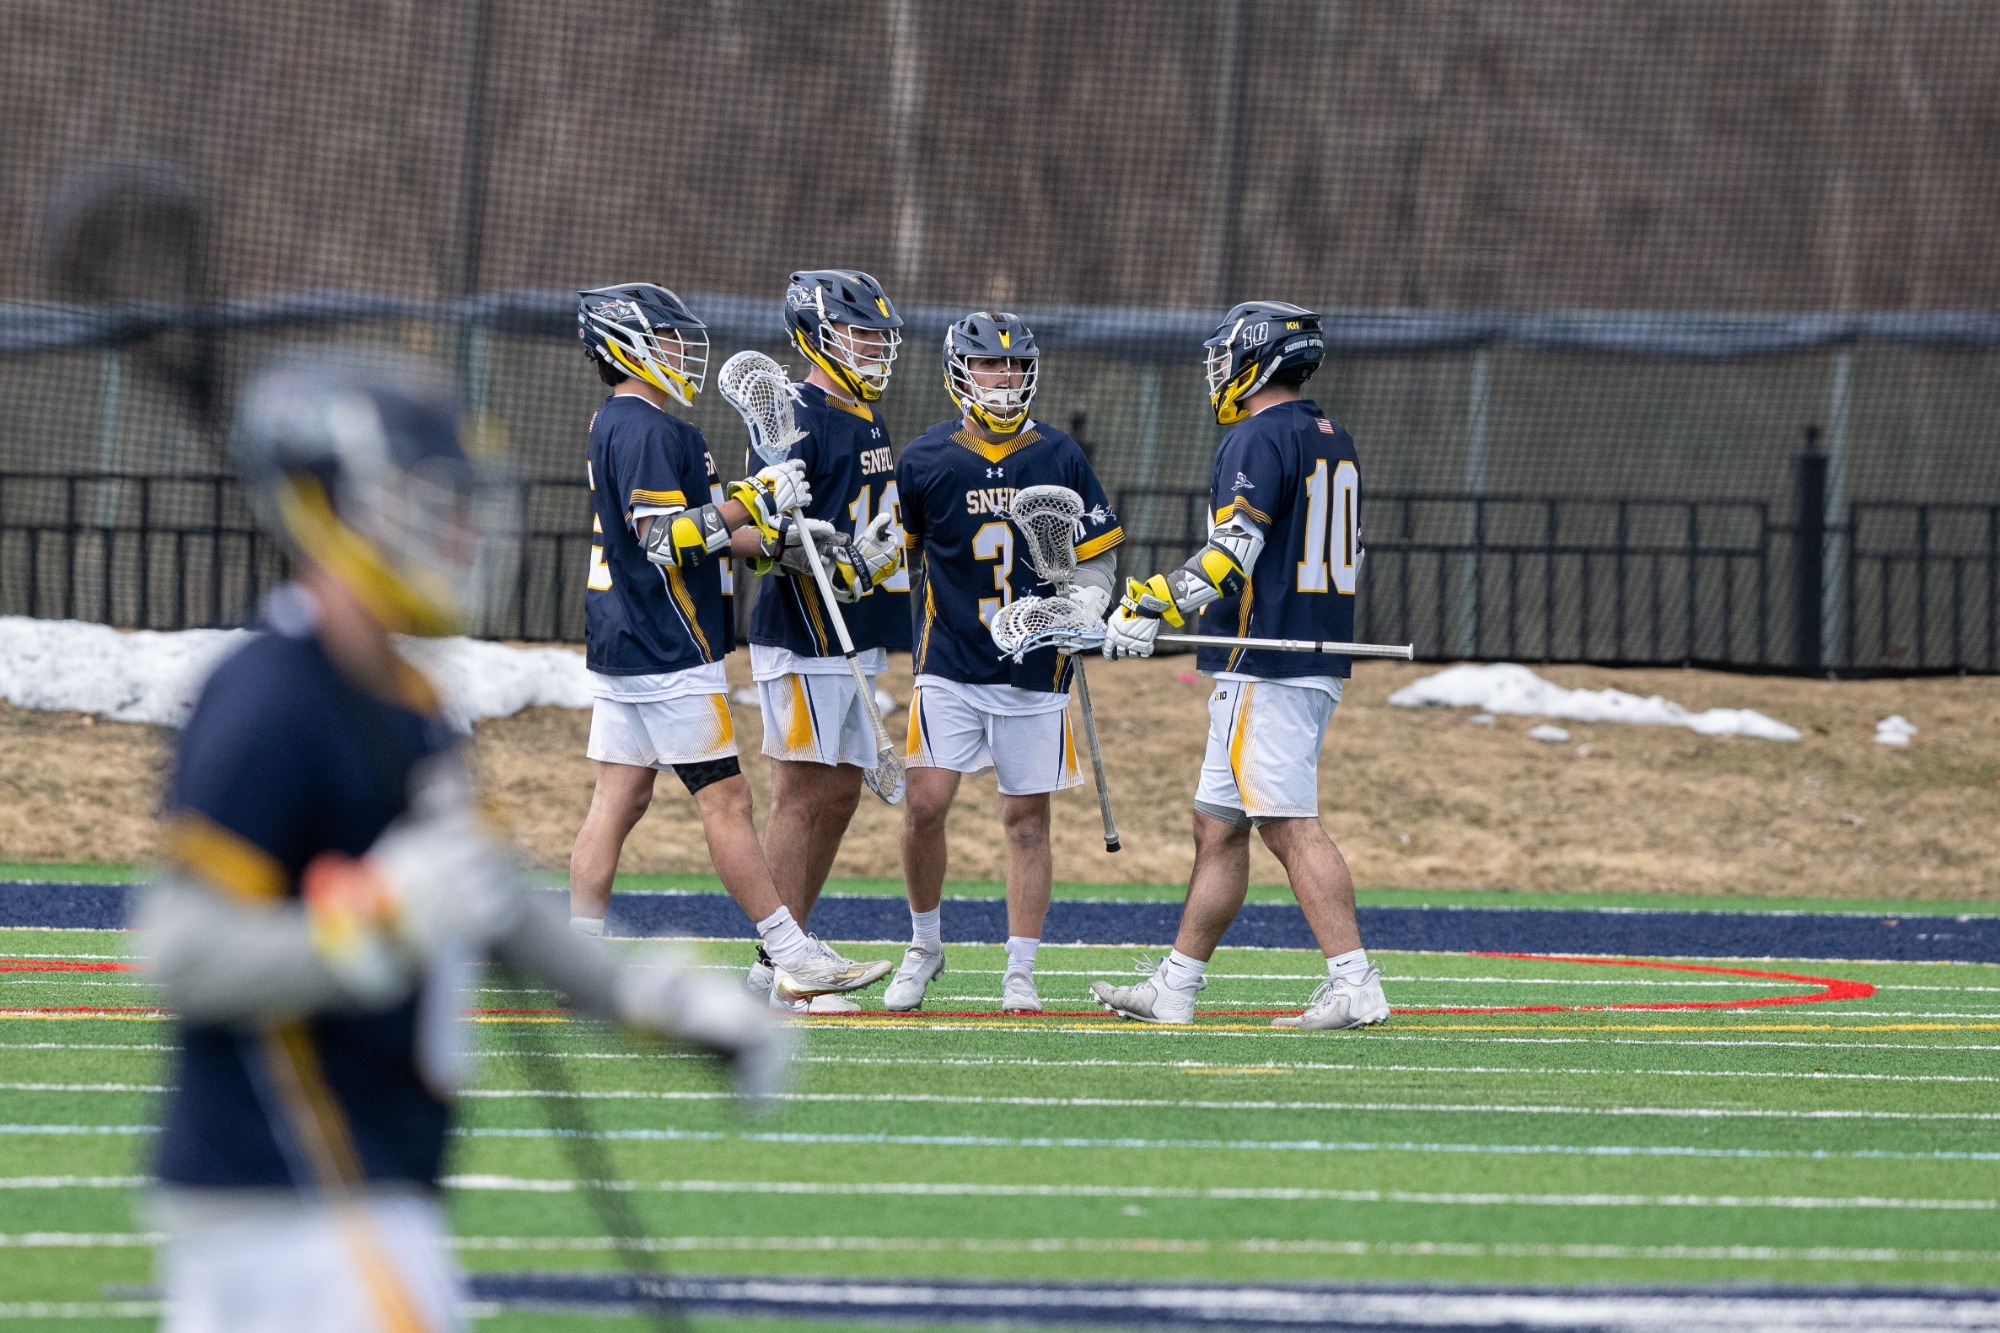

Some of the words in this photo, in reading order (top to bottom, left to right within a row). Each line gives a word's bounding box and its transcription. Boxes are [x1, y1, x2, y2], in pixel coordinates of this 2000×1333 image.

[1242, 321, 1269, 350] 10
[1286, 321, 1300, 331] KH
[860, 446, 895, 476] SNHU
[1297, 458, 1359, 595] 10
[972, 522, 1014, 632] 3
